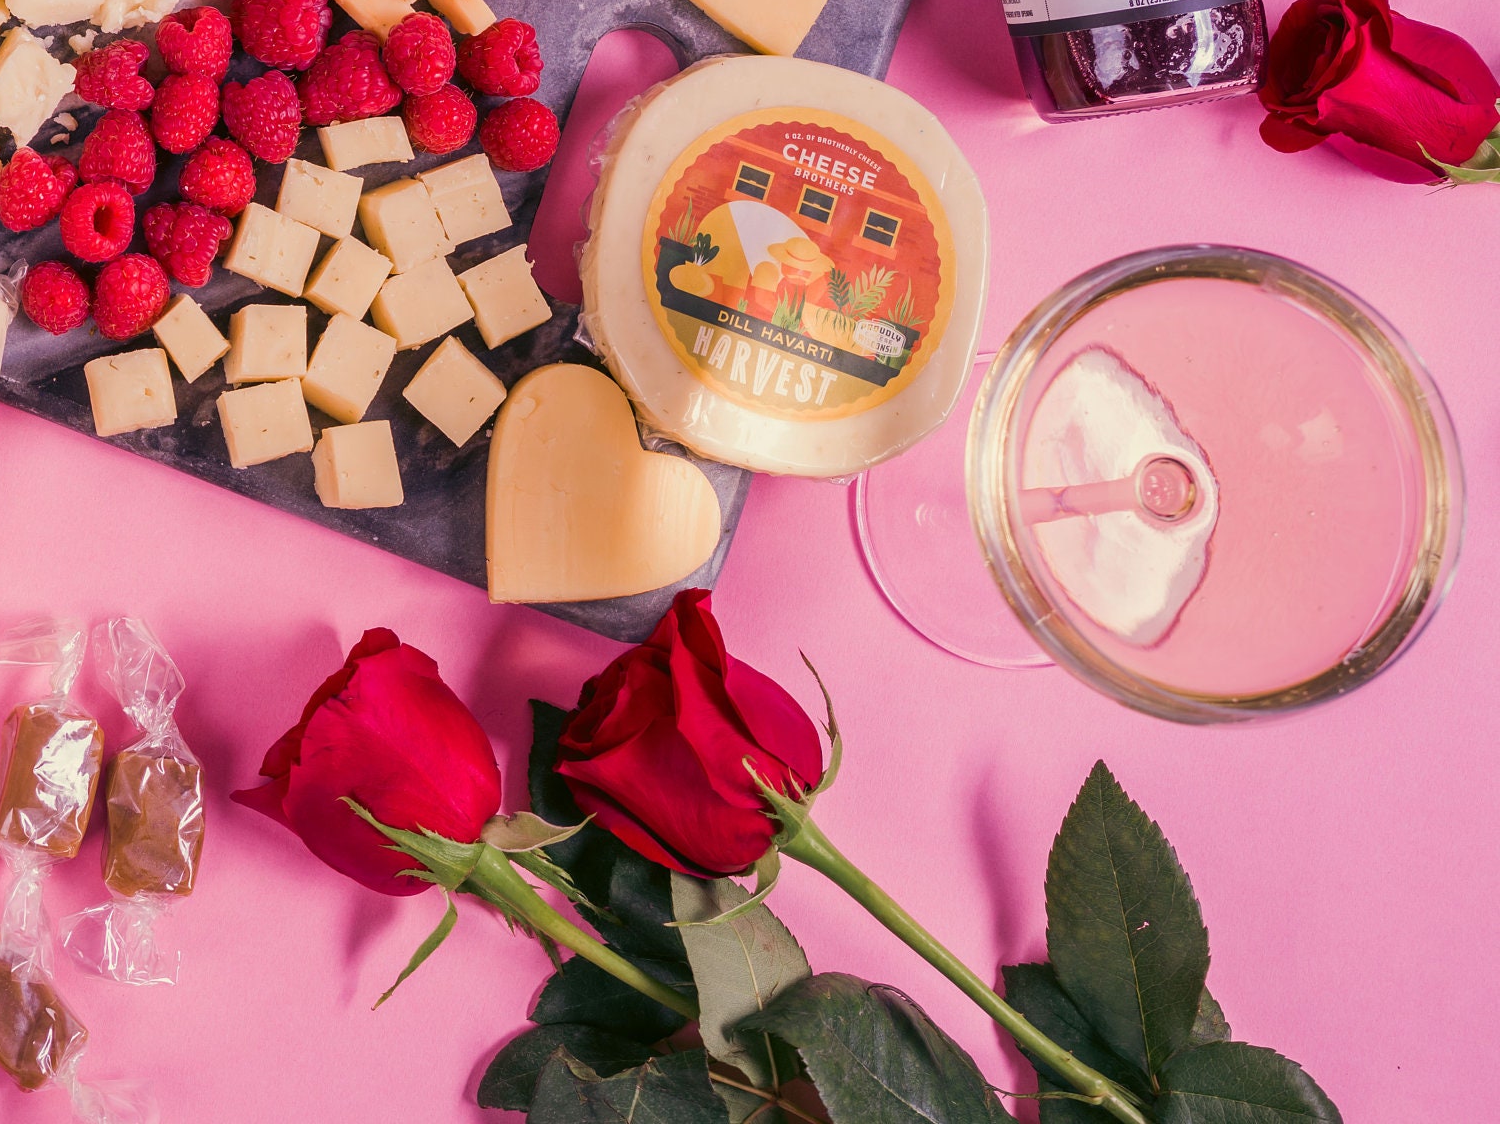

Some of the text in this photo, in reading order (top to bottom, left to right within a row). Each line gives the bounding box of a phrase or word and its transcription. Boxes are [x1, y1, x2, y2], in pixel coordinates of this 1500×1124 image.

[783, 143, 877, 190] CHEESE
[817, 137, 857, 155] BROTHERLY
[858, 153, 882, 173] CHEESE
[794, 167, 855, 196] BROTHERS
[717, 310, 753, 334] DILL
[761, 327, 834, 363] HAVARTI
[692, 325, 838, 406] HARVEST
